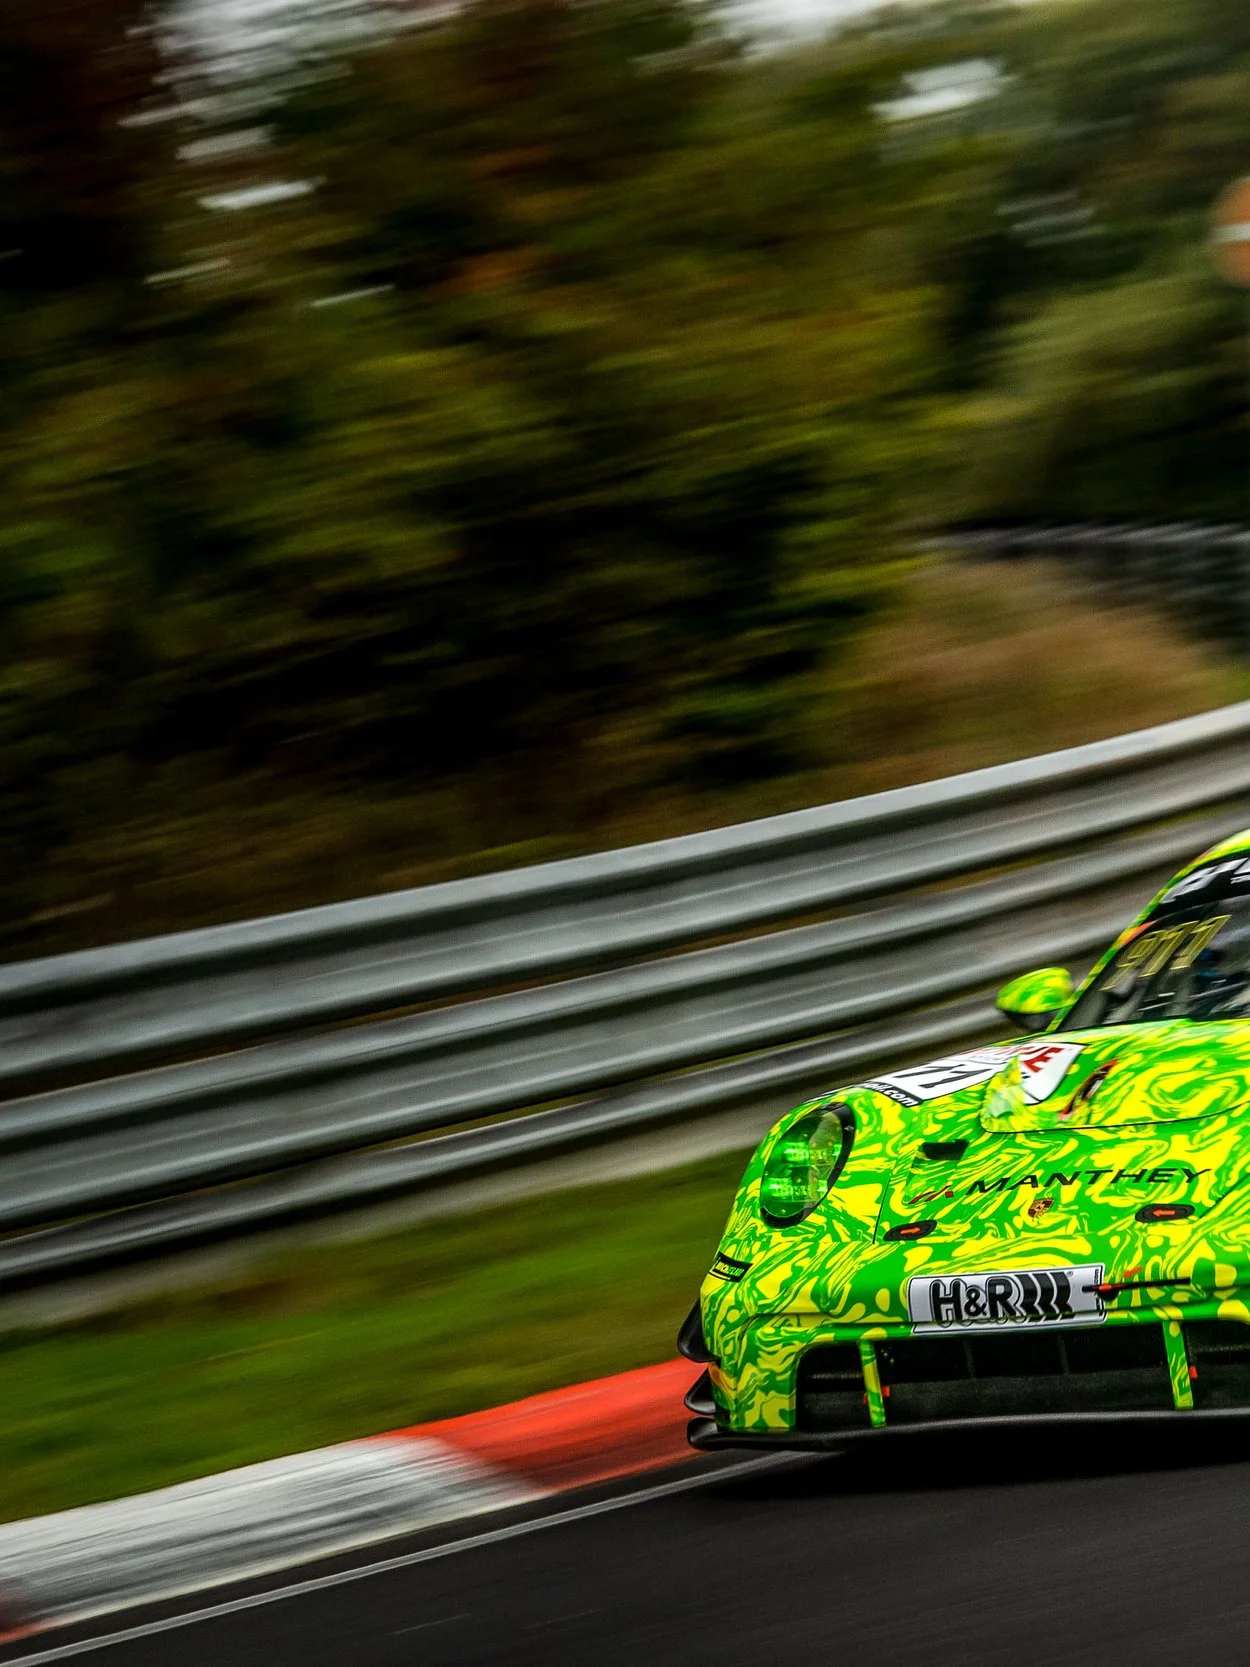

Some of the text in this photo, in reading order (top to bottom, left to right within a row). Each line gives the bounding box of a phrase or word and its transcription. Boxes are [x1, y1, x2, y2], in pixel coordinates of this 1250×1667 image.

[1099, 914, 1233, 991] 911
[965, 1168, 1212, 1196] MANTHEY
[931, 1275, 1018, 1326] H&R
